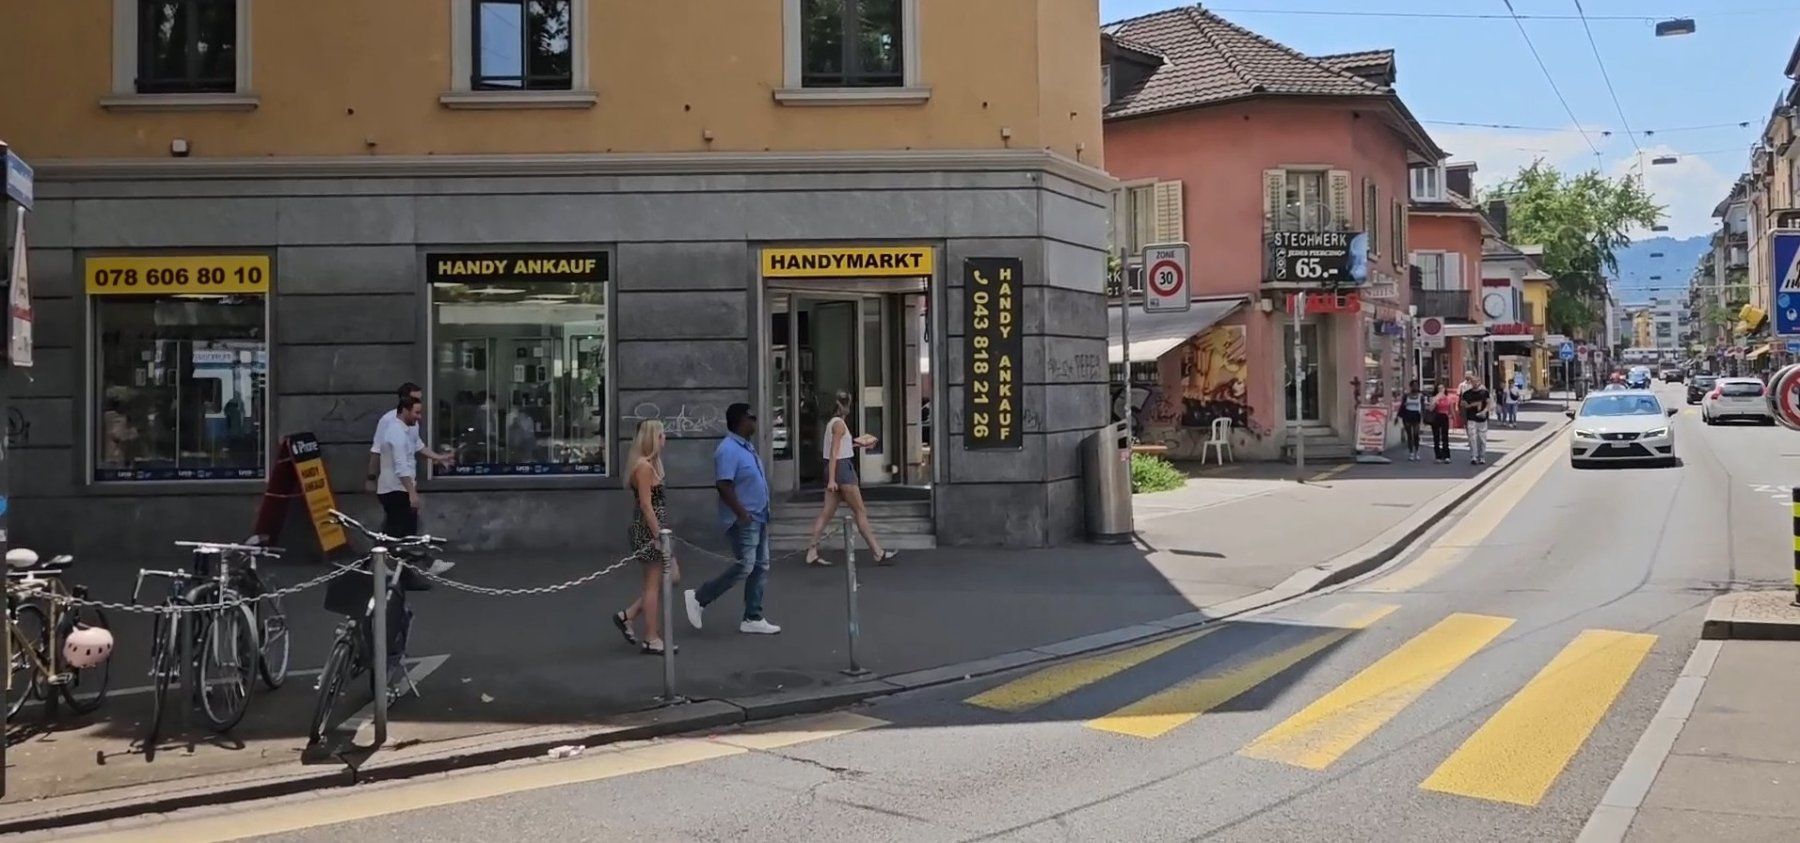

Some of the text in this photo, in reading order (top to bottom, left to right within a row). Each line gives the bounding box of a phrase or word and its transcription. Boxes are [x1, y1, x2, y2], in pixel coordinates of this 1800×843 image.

[1274, 232, 1347, 247] STECHWERK
[771, 253, 923, 270] HANDYMARKT
[1156, 250, 1176, 259] ZONE
[438, 259, 597, 276] HANDY ANKAUF
[1295, 258, 1339, 278] 65.-
[95, 266, 262, 287] 078 606 80 10
[1159, 271, 1174, 286] 30
[999, 267, 1012, 440] HANDY ANKAUF
[973, 291, 989, 438] 043 818 21 26
